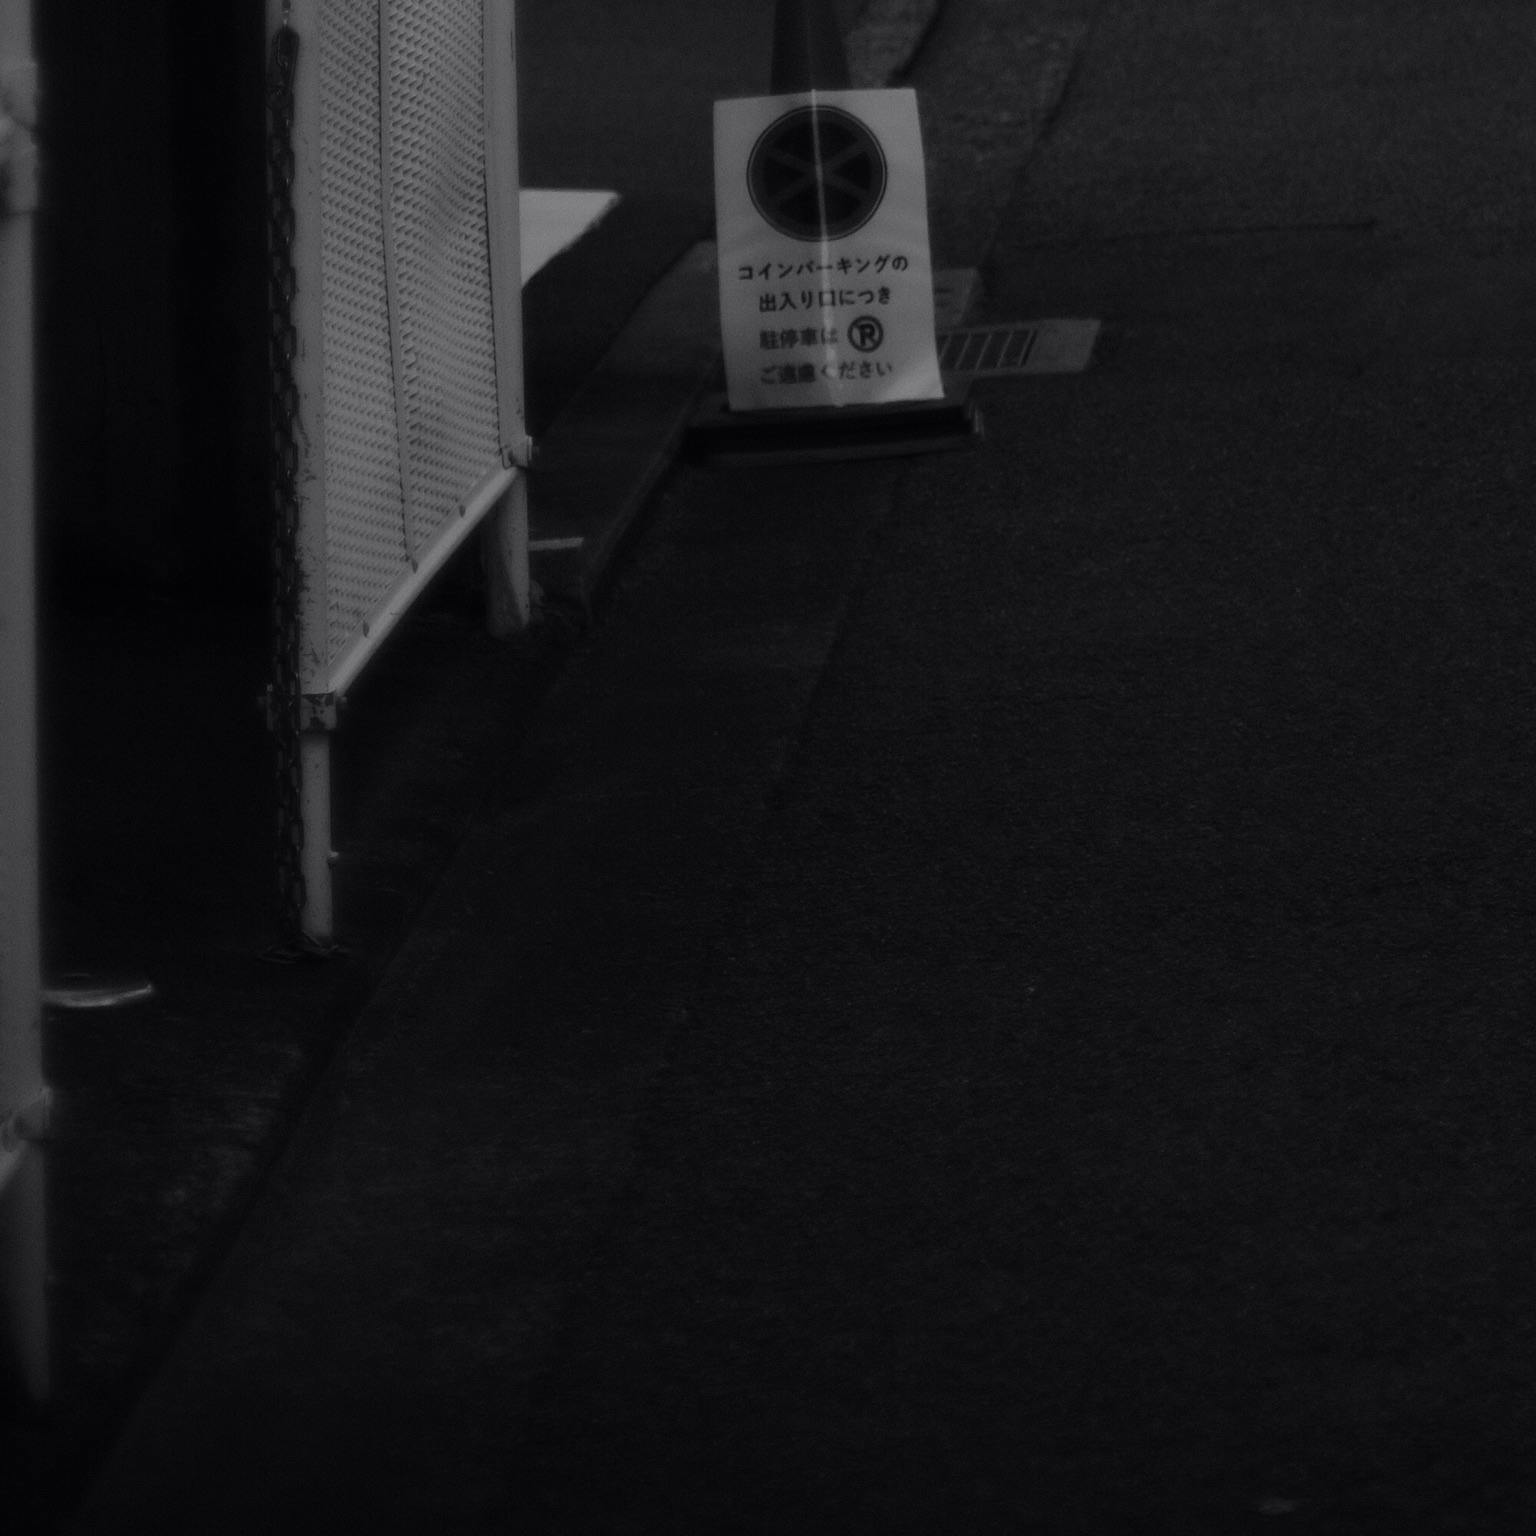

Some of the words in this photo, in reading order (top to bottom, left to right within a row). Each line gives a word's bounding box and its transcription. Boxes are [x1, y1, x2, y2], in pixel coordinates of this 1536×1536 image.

[738, 254, 910, 283] コインパーキングの
[758, 286, 892, 314] 出入り口につき
